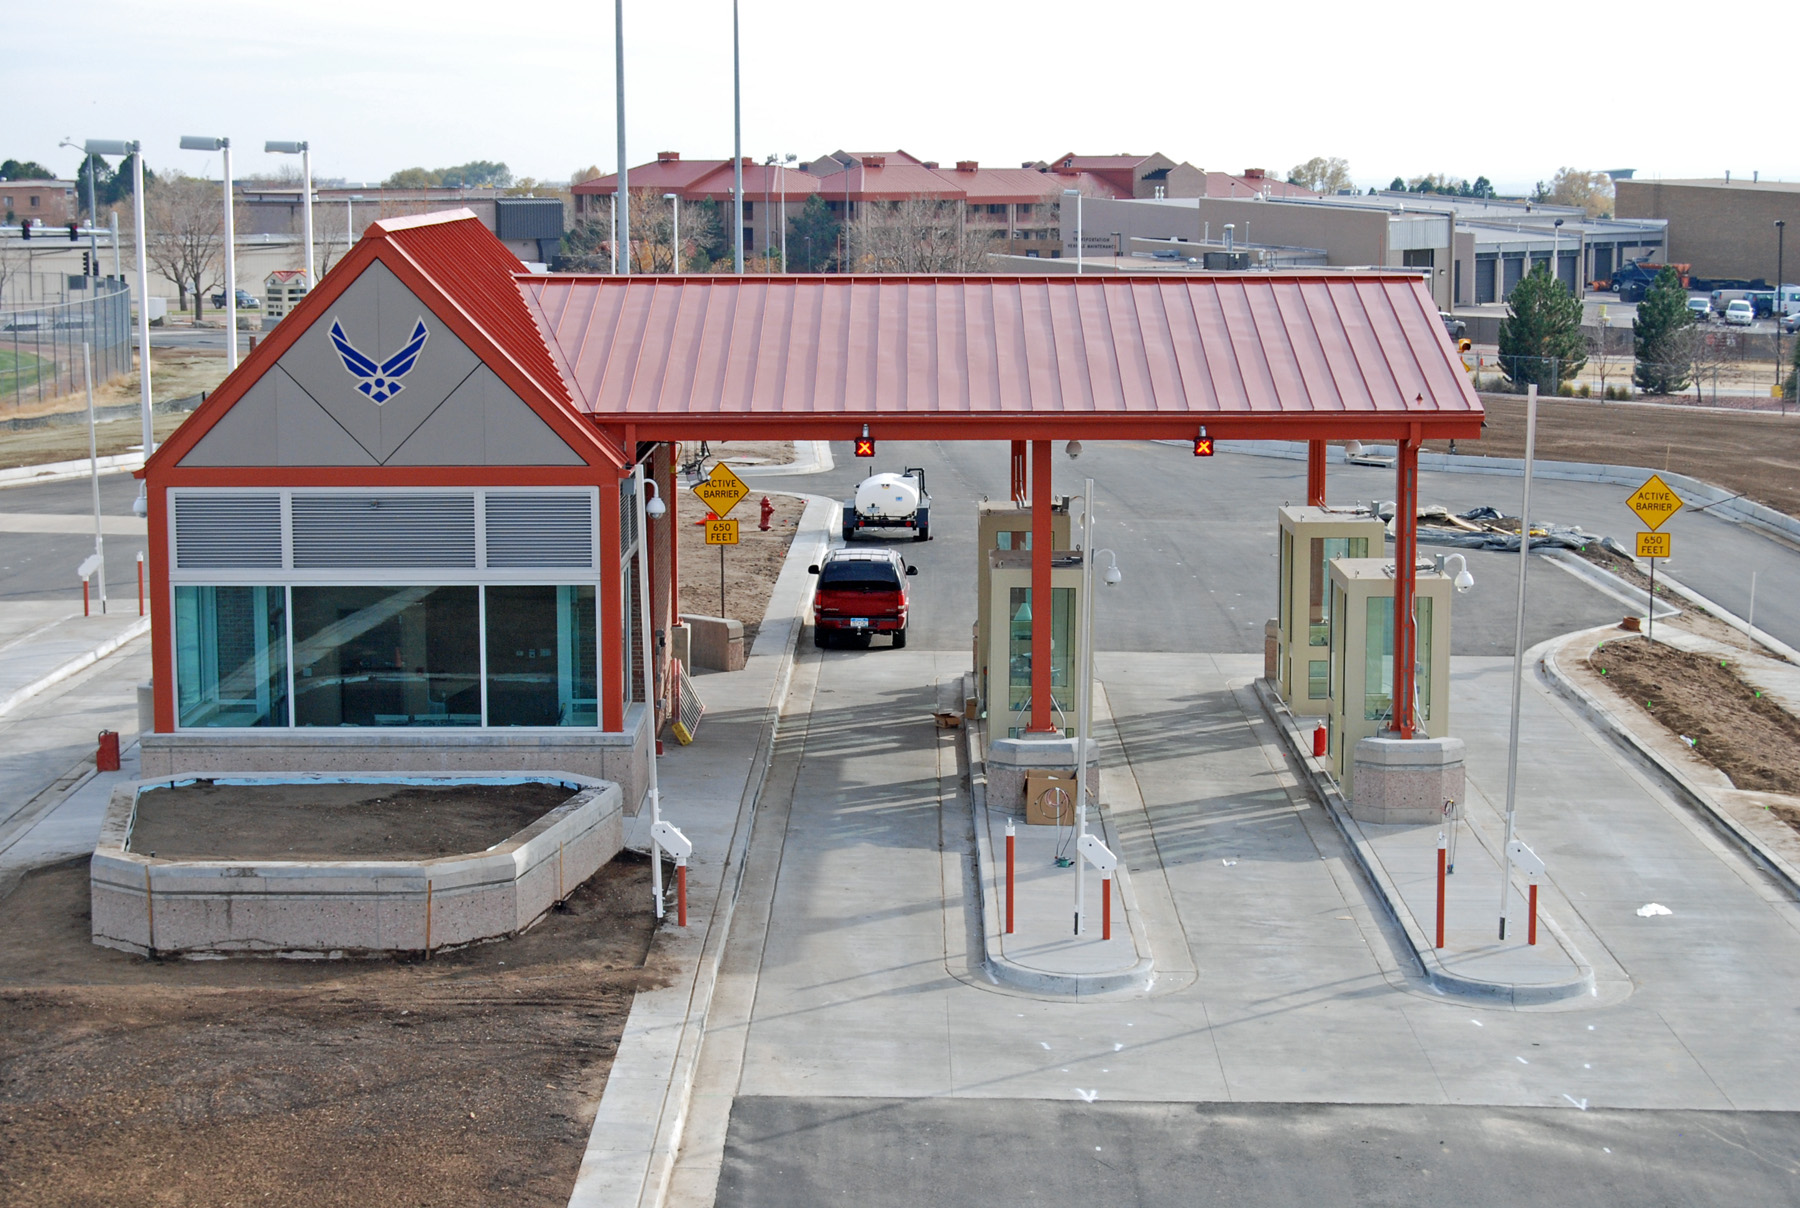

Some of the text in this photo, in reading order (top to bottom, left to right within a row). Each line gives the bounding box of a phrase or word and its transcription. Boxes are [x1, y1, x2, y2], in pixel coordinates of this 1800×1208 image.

[705, 479, 737, 488] ACTIVE
[703, 490, 740, 498] BARRIER
[1638, 492, 1671, 501] ACTIVE
[1636, 502, 1673, 512] BARRIER
[713, 523, 731, 532] 650
[710, 533, 733, 541] FEET
[1644, 536, 1663, 545] 650
[1641, 545, 1664, 555] FEET
